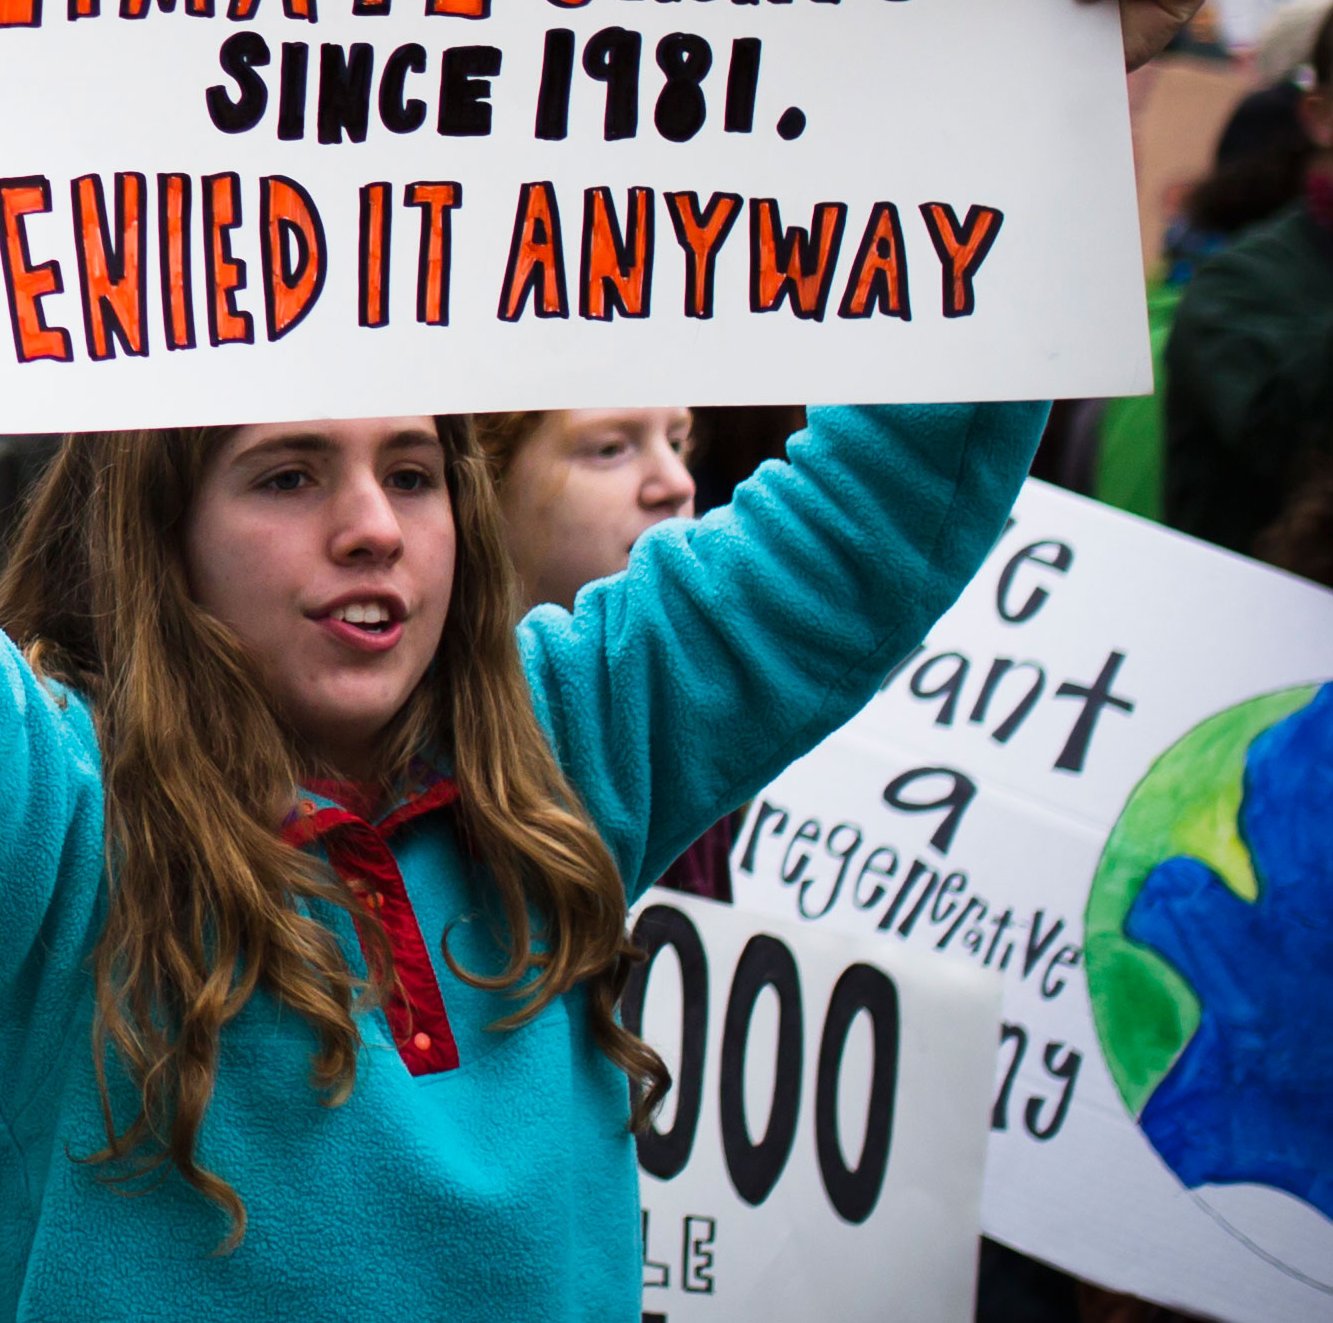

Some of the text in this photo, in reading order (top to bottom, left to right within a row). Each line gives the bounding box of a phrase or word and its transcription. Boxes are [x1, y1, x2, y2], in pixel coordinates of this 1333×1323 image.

[206, 27, 810, 143] SINCE 1981.
[356, 179, 464, 329] IT
[498, 179, 1006, 322] ANYWAY
[992, 515, 1074, 625] e
[740, 799, 1086, 999] regenerative
